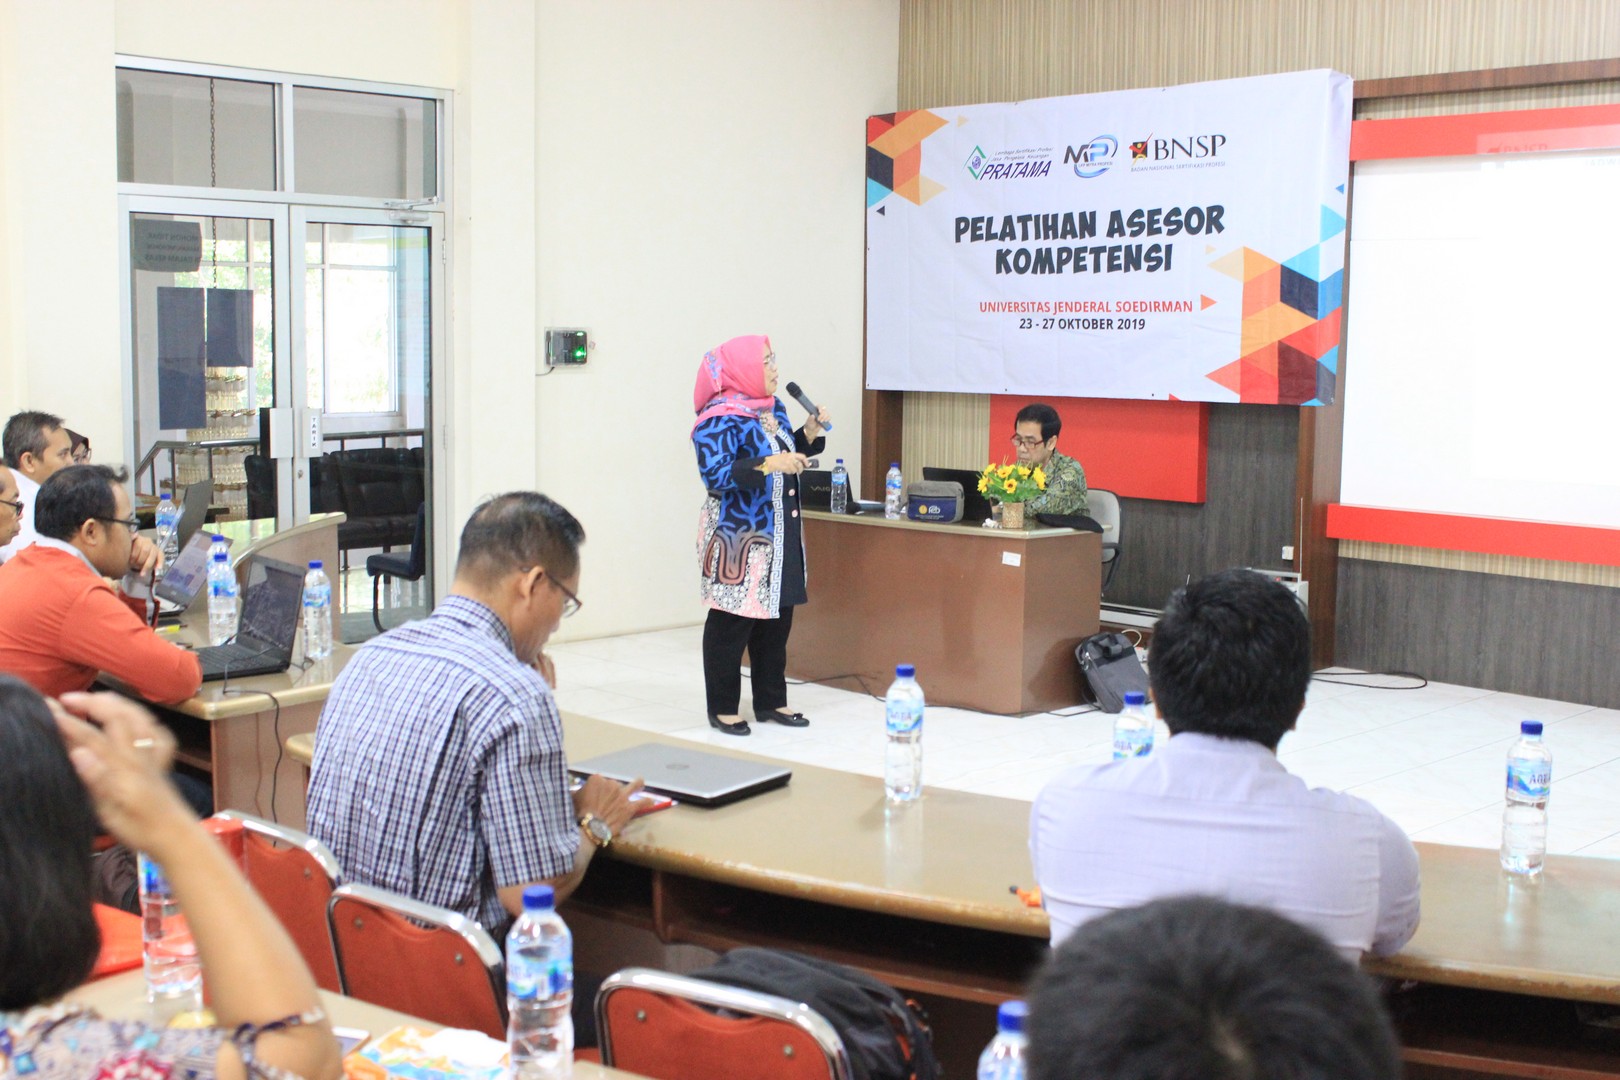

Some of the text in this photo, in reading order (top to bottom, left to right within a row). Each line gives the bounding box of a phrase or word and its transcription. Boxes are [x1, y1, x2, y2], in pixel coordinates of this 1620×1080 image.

[1154, 134, 1226, 161] BNSP
[980, 160, 1053, 180] PRATAMA
[955, 204, 1226, 243] PELATIHAN ASESOR
[995, 243, 1173, 275] KOMPETENSI
[979, 301, 1193, 315] UNIVERSITAS JENDERAL SOEDIRMAN
[1019, 318, 1033, 329] 23
[1042, 318, 1055, 329] 27
[1058, 318, 1114, 330] OKTOBER
[1117, 318, 1146, 330] 2019
